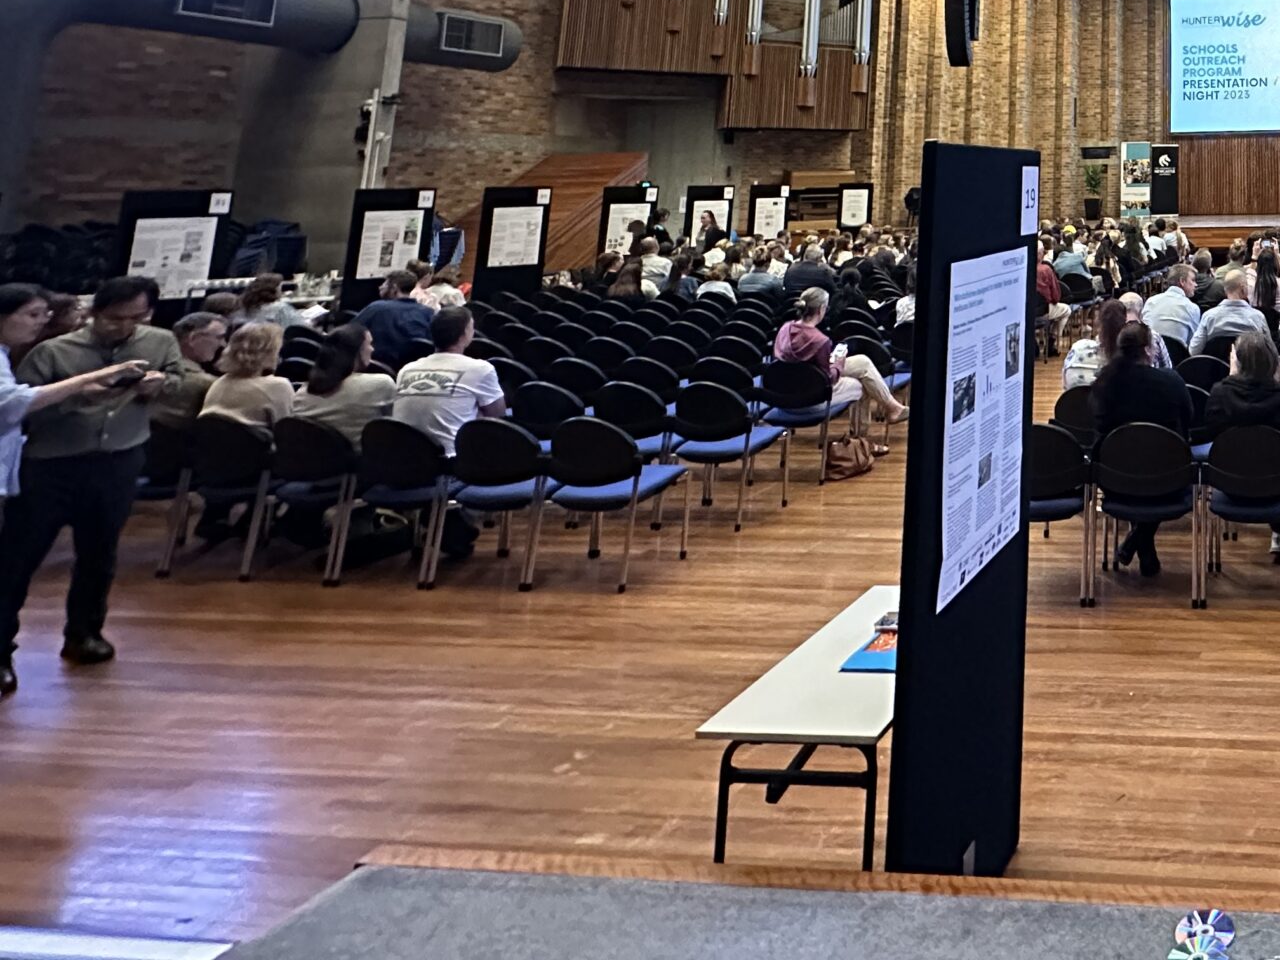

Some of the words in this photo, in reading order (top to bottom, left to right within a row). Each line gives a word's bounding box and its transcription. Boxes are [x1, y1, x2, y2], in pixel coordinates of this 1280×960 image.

[1182, 44, 1238, 55] SCHOOLS
[1182, 55, 1246, 66] OUTREACH
[1182, 66, 1242, 77] PROGRAM
[1183, 77, 1268, 89] PRESENTATION
[1183, 90, 1220, 101] NIGHT
[1223, 89, 1250, 100] 2023
[1025, 188, 1036, 209] 19
